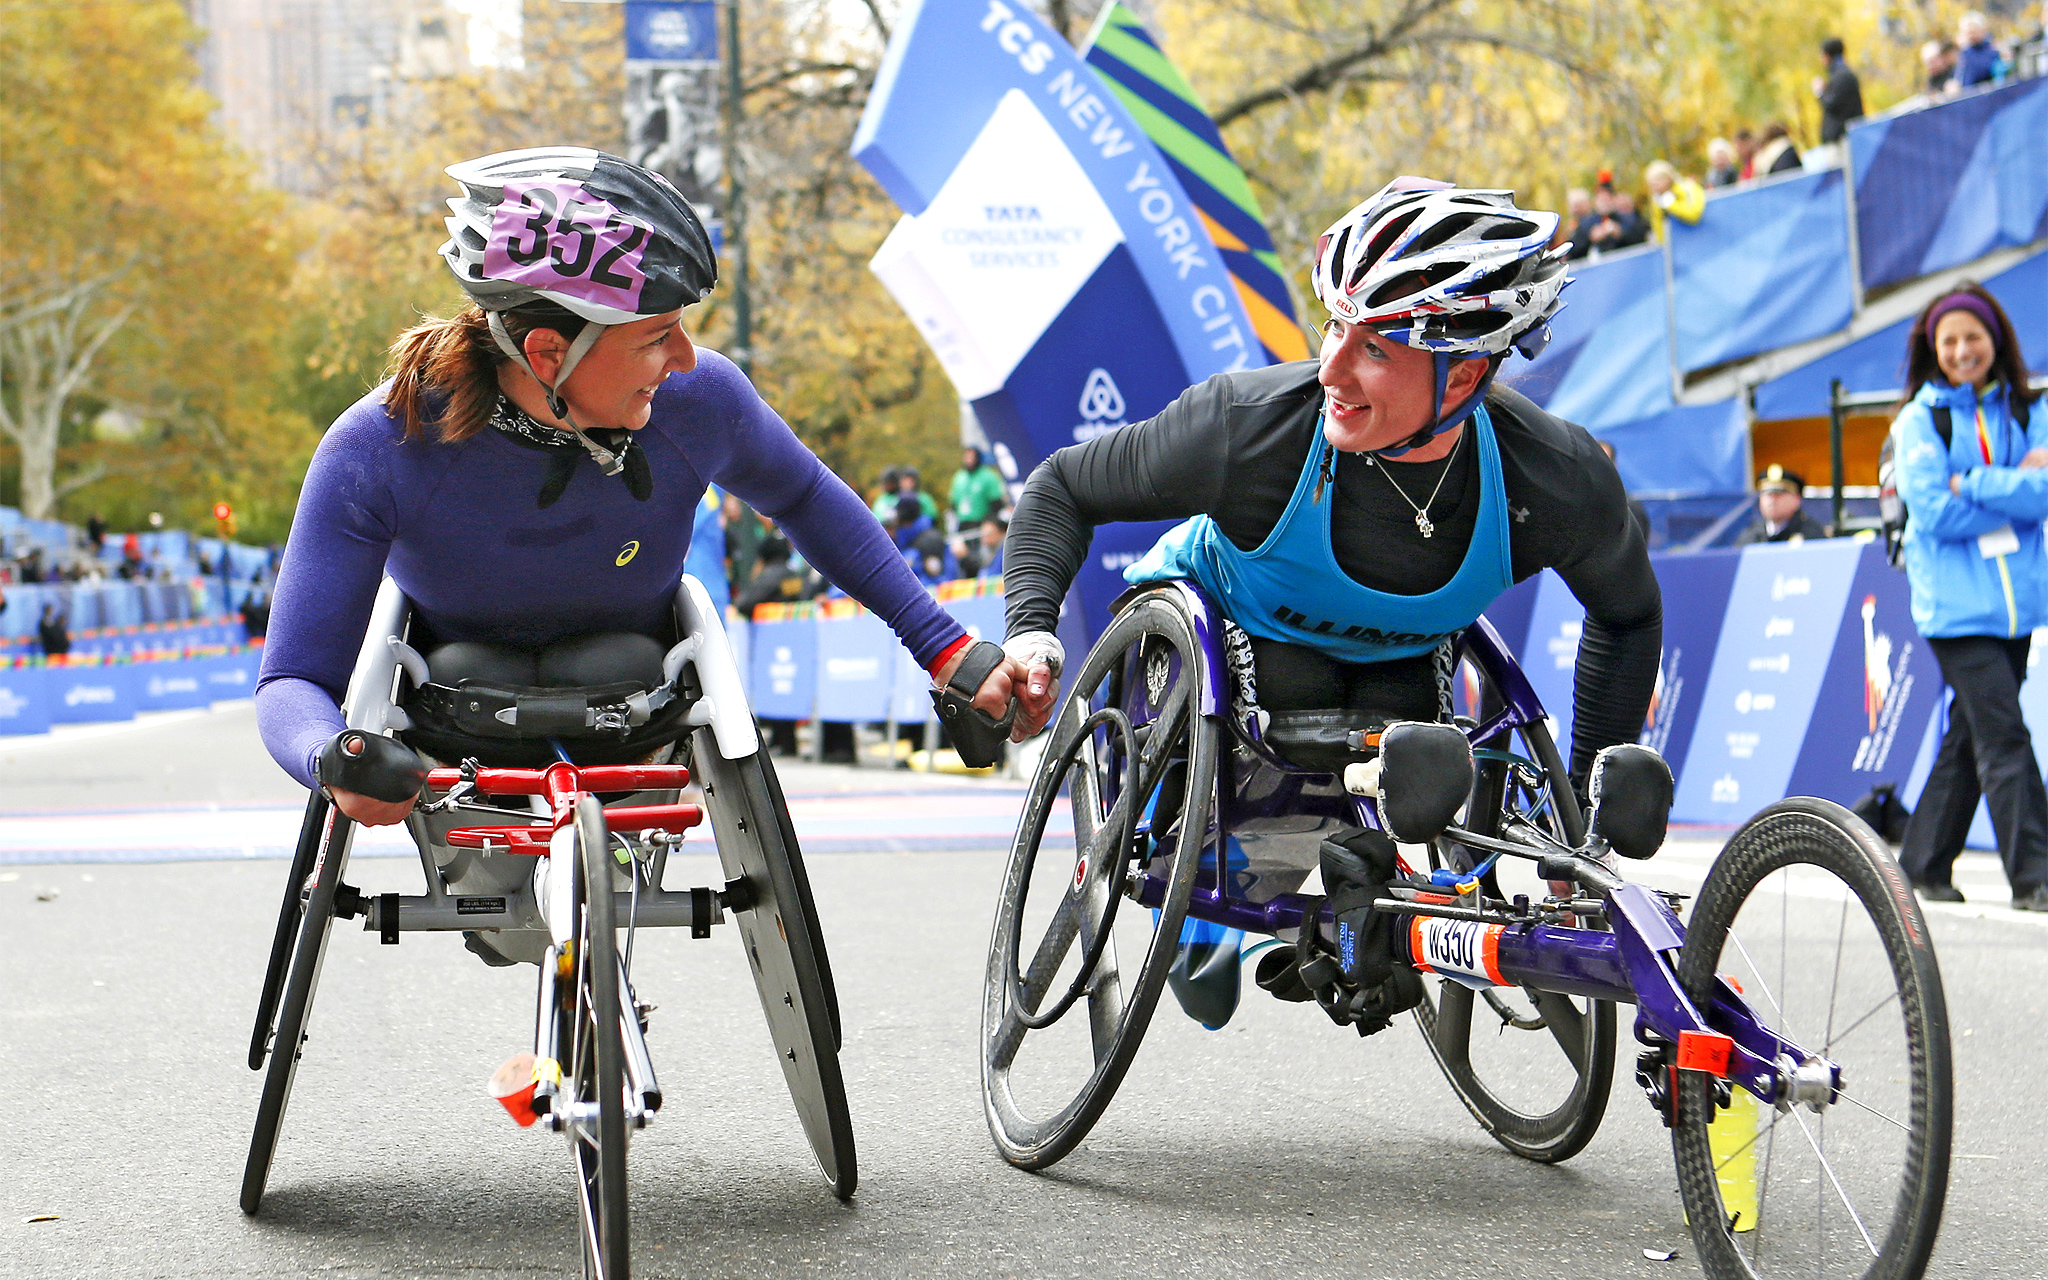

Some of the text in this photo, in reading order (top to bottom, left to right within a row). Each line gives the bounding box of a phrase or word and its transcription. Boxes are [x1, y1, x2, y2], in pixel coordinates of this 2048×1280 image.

[980, 0, 1252, 373] TCS NEW YORK CITY
[983, 205, 1042, 222] TATA
[506, 188, 646, 290] 352
[941, 228, 1084, 245] CONSULTANCY
[969, 251, 1059, 268] SERVICES
[1336, 299, 1353, 315] BELL
[1429, 918, 1480, 971] W350
